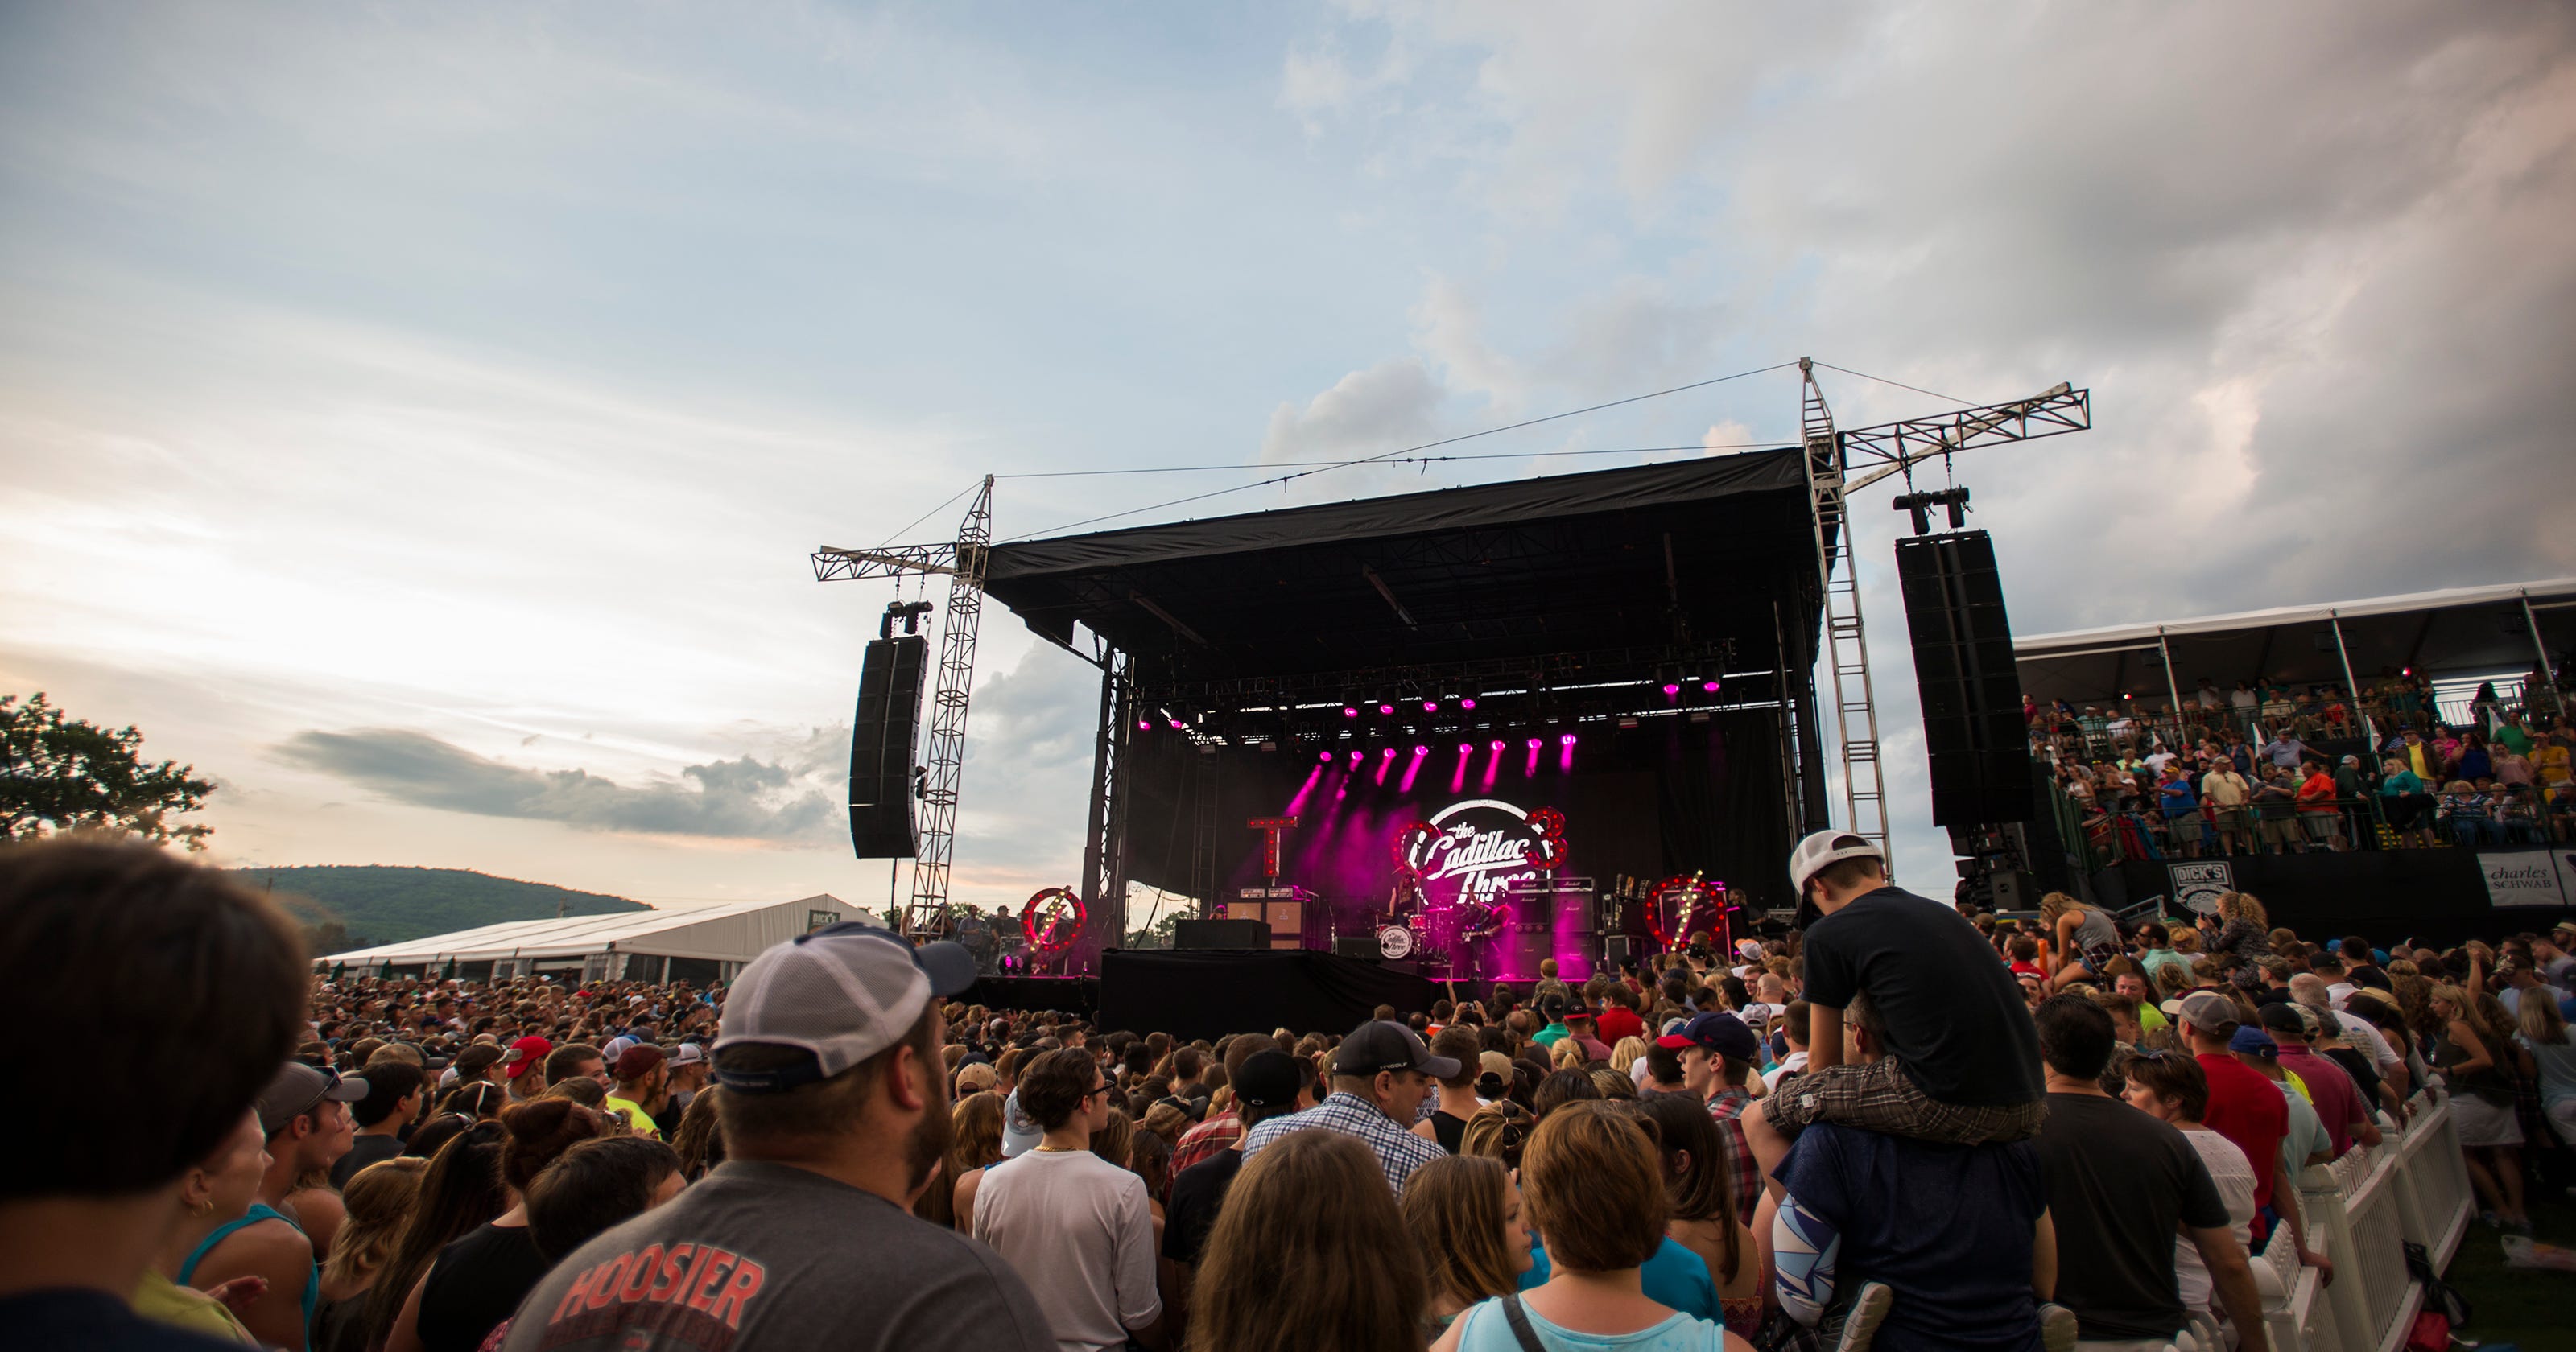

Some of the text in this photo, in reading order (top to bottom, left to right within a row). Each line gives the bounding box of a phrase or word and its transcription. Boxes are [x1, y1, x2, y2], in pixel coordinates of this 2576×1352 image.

[1447, 822, 1476, 839] the
[1248, 816, 1298, 877] T
[1525, 806, 1569, 871] 3
[1424, 830, 1530, 880] Cadillac
[2178, 865, 2223, 880] DICK'S
[2491, 865, 2548, 880] charles
[2493, 880, 2552, 889] SCHWAB
[548, 1243, 765, 1332] HOOSIER
